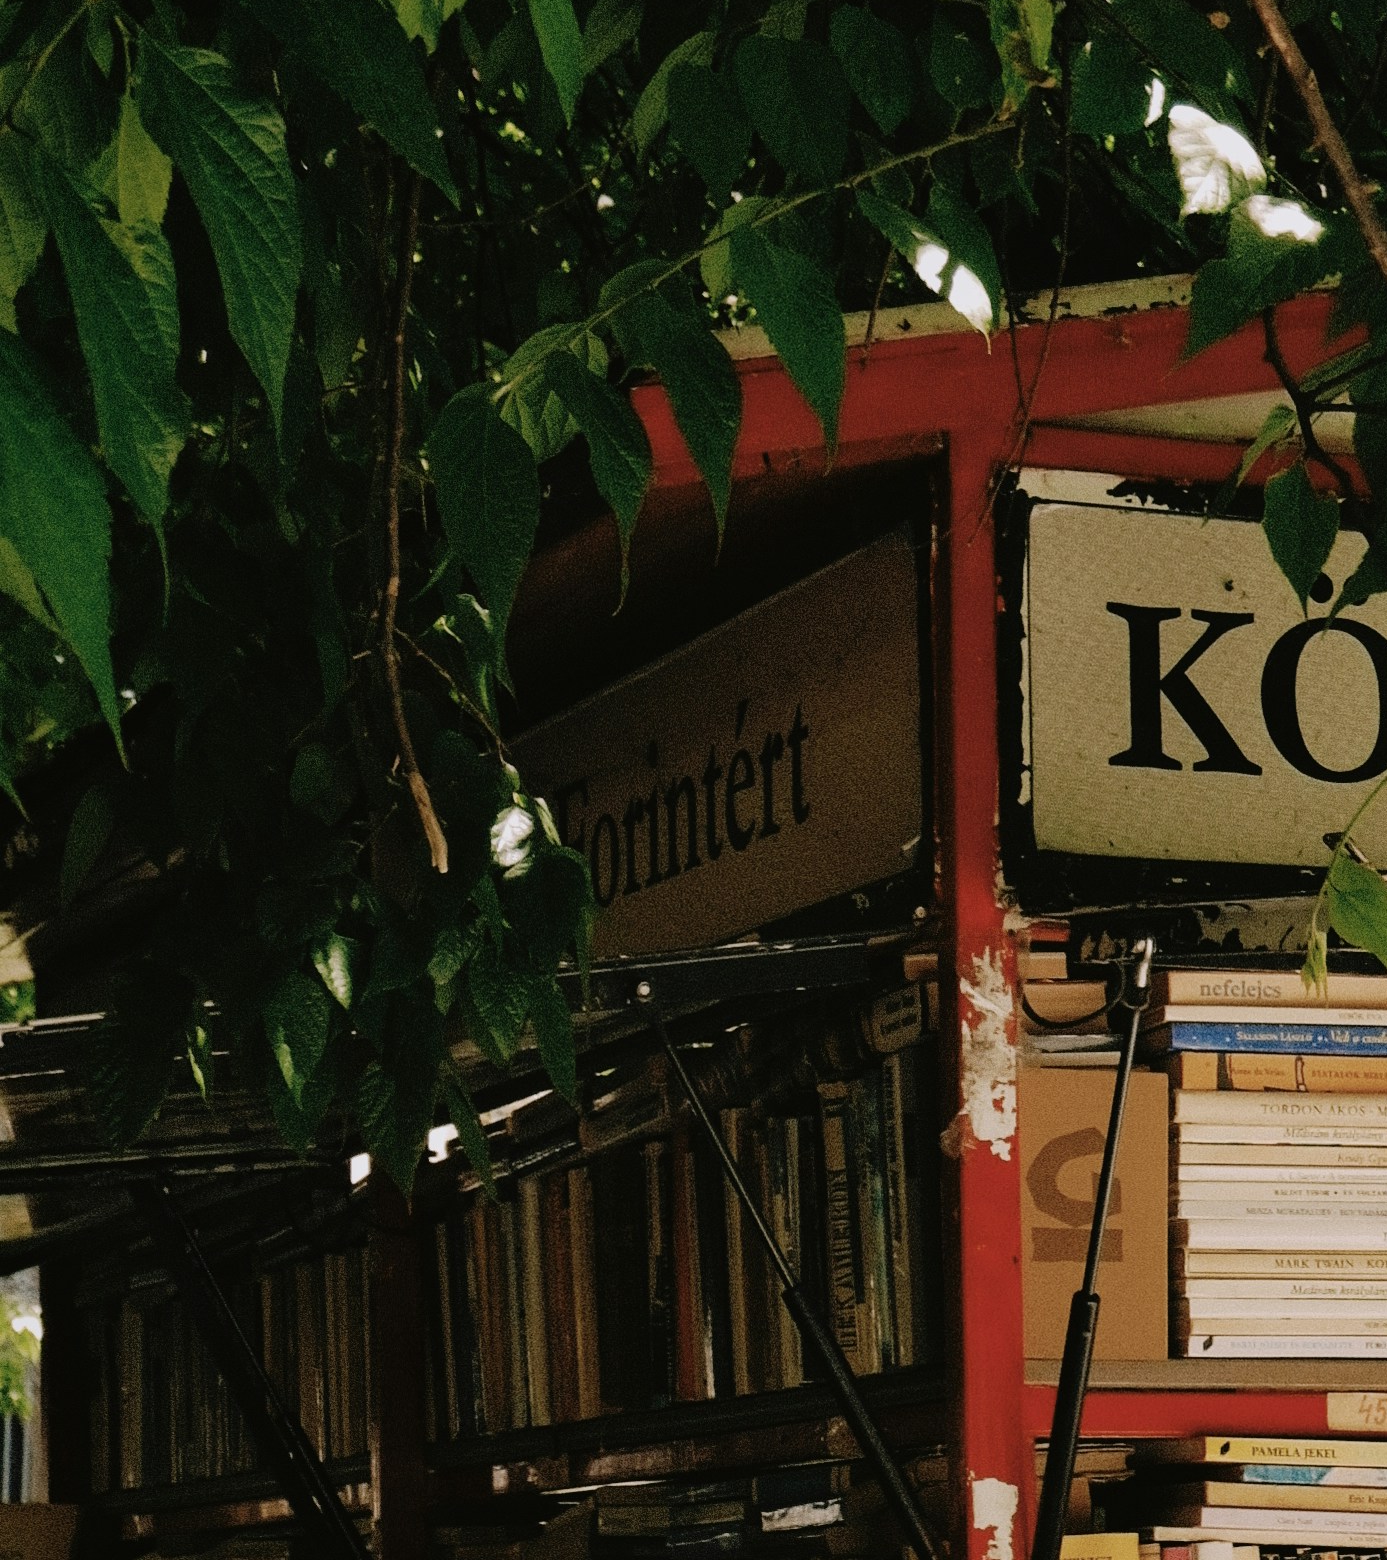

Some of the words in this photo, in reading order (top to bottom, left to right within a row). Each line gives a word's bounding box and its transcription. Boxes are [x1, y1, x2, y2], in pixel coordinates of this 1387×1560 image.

[1199, 979, 1282, 999] nefelejcs
[1260, 1104, 1322, 1116] TORDON
[1275, 1257, 1309, 1270] MARK
[1315, 1258, 1355, 1270] TWAIN
[1252, 1445, 1300, 1457] PAMELA
[1304, 1448, 1336, 1460] JEKEL
